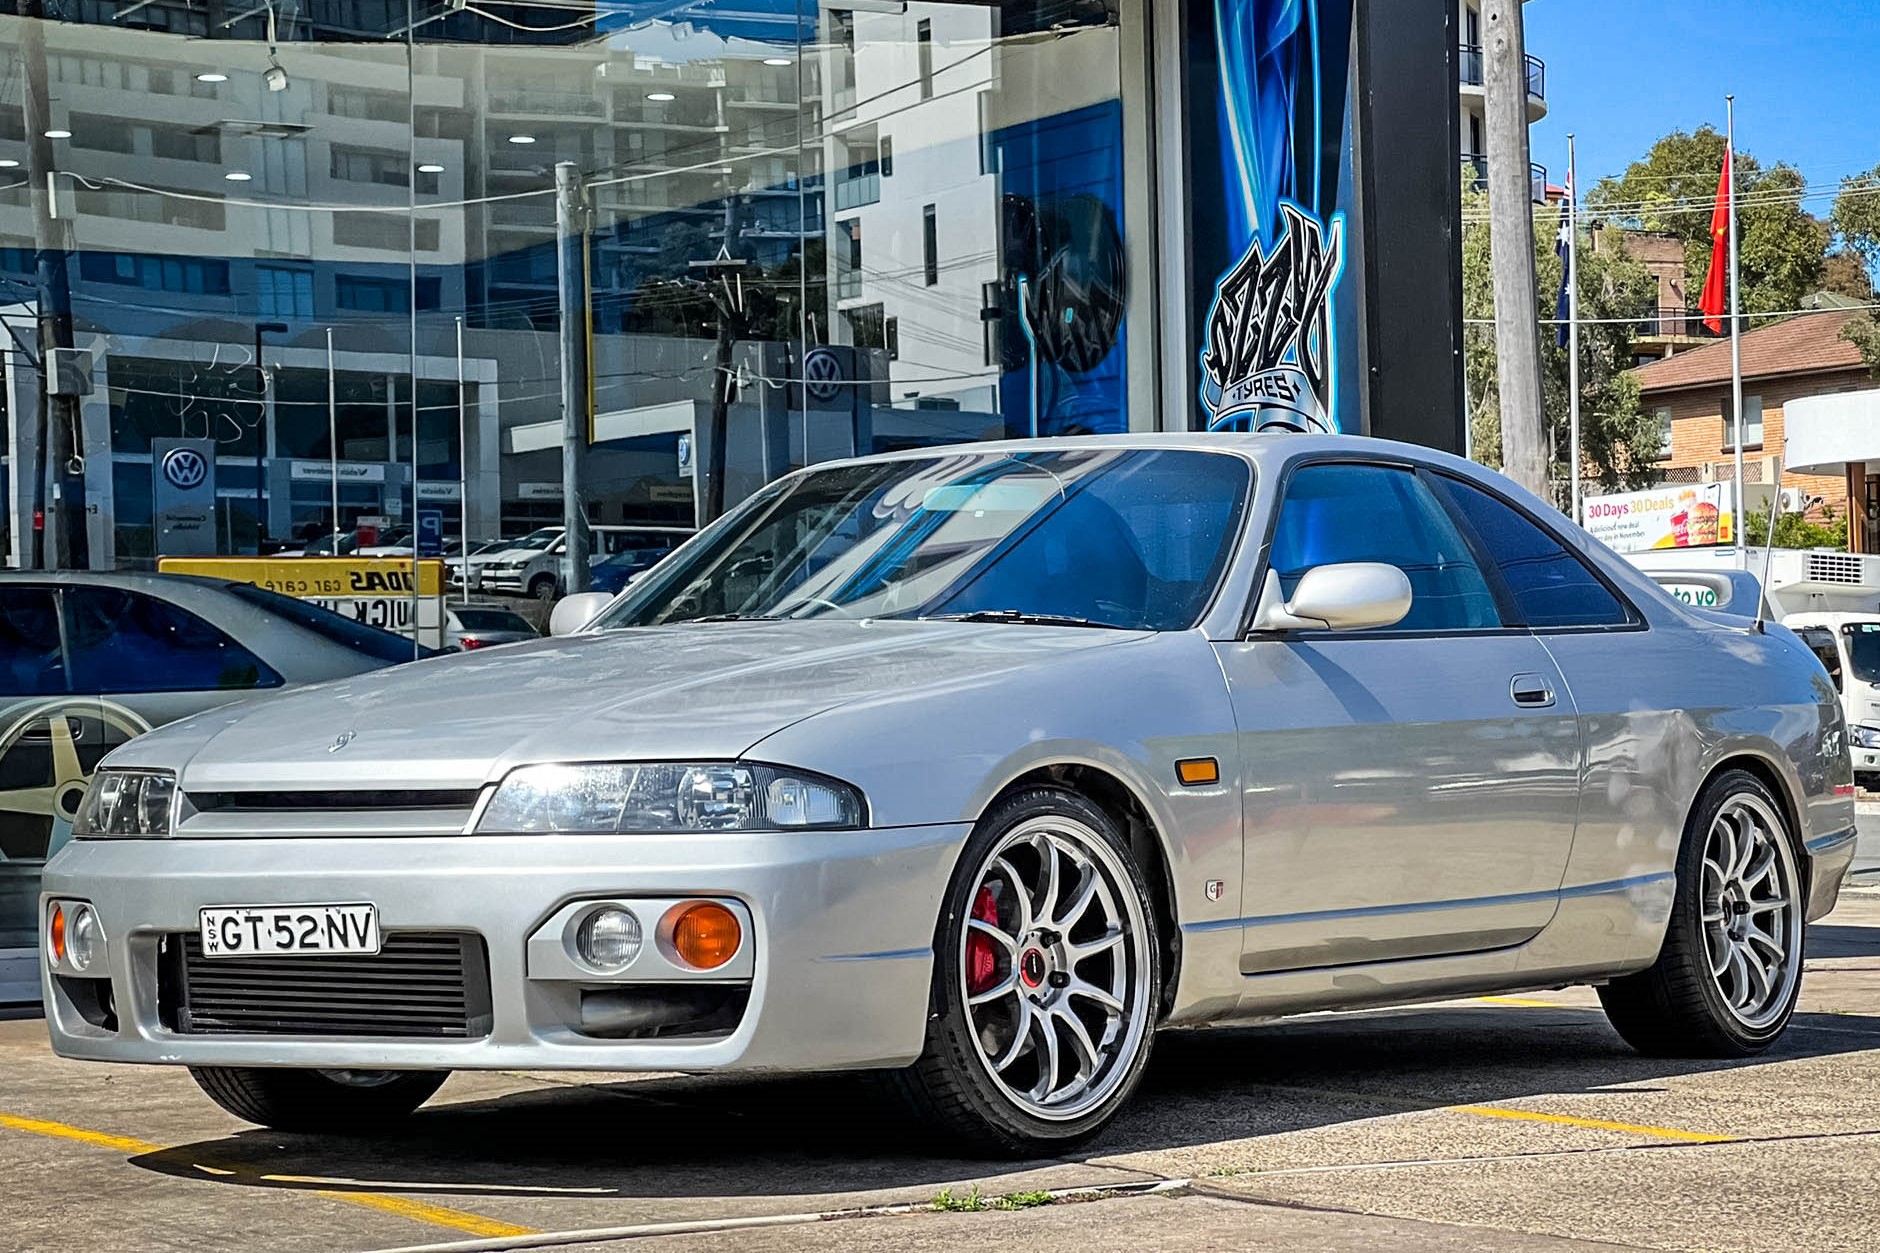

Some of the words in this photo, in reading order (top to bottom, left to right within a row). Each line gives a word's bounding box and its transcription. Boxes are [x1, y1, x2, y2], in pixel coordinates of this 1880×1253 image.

[1236, 373, 1296, 402] TYRES
[1589, 504, 1601, 519] 30
[1603, 503, 1629, 519] Days
[1631, 500, 1643, 514] 30
[1645, 495, 1674, 511] Deals
[1620, 530, 1646, 539] November
